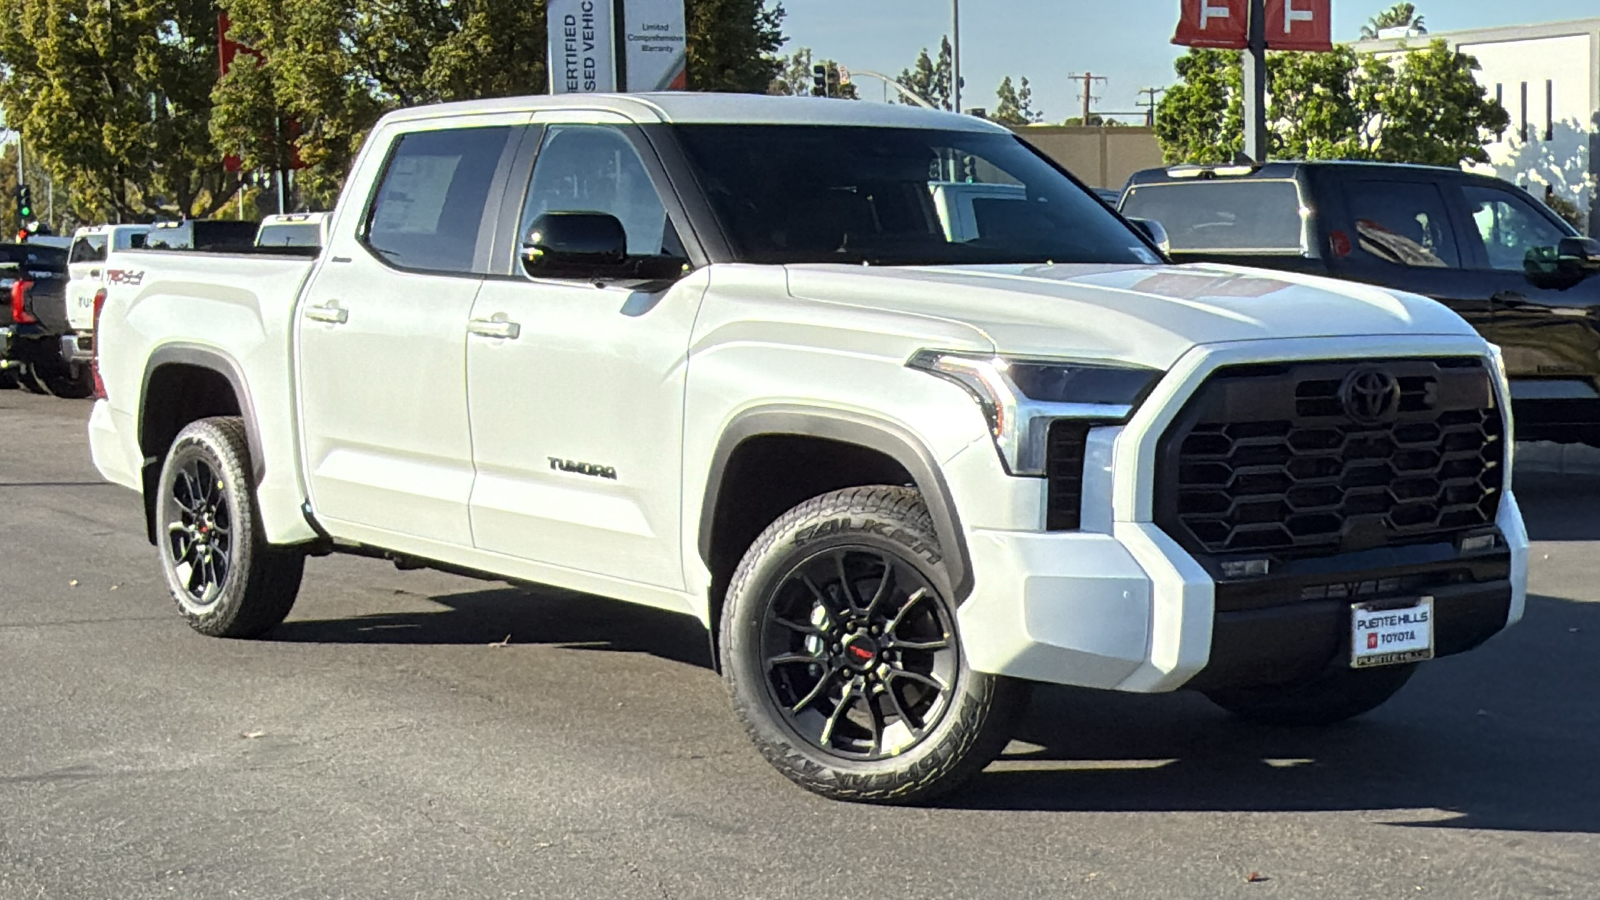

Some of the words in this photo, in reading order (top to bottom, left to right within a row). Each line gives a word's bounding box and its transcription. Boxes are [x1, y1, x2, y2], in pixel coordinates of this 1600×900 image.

[642, 23, 669, 31] Limited
[627, 34, 683, 42] Comprehensive
[565, 14, 578, 93] ERTIFIED
[641, 45, 673, 53] Warranty
[547, 456, 617, 480] TUNDRA
[1357, 615, 1397, 630] PUENTE
[1398, 611, 1428, 624] HILLS
[1381, 630, 1415, 644] TOYOTA
